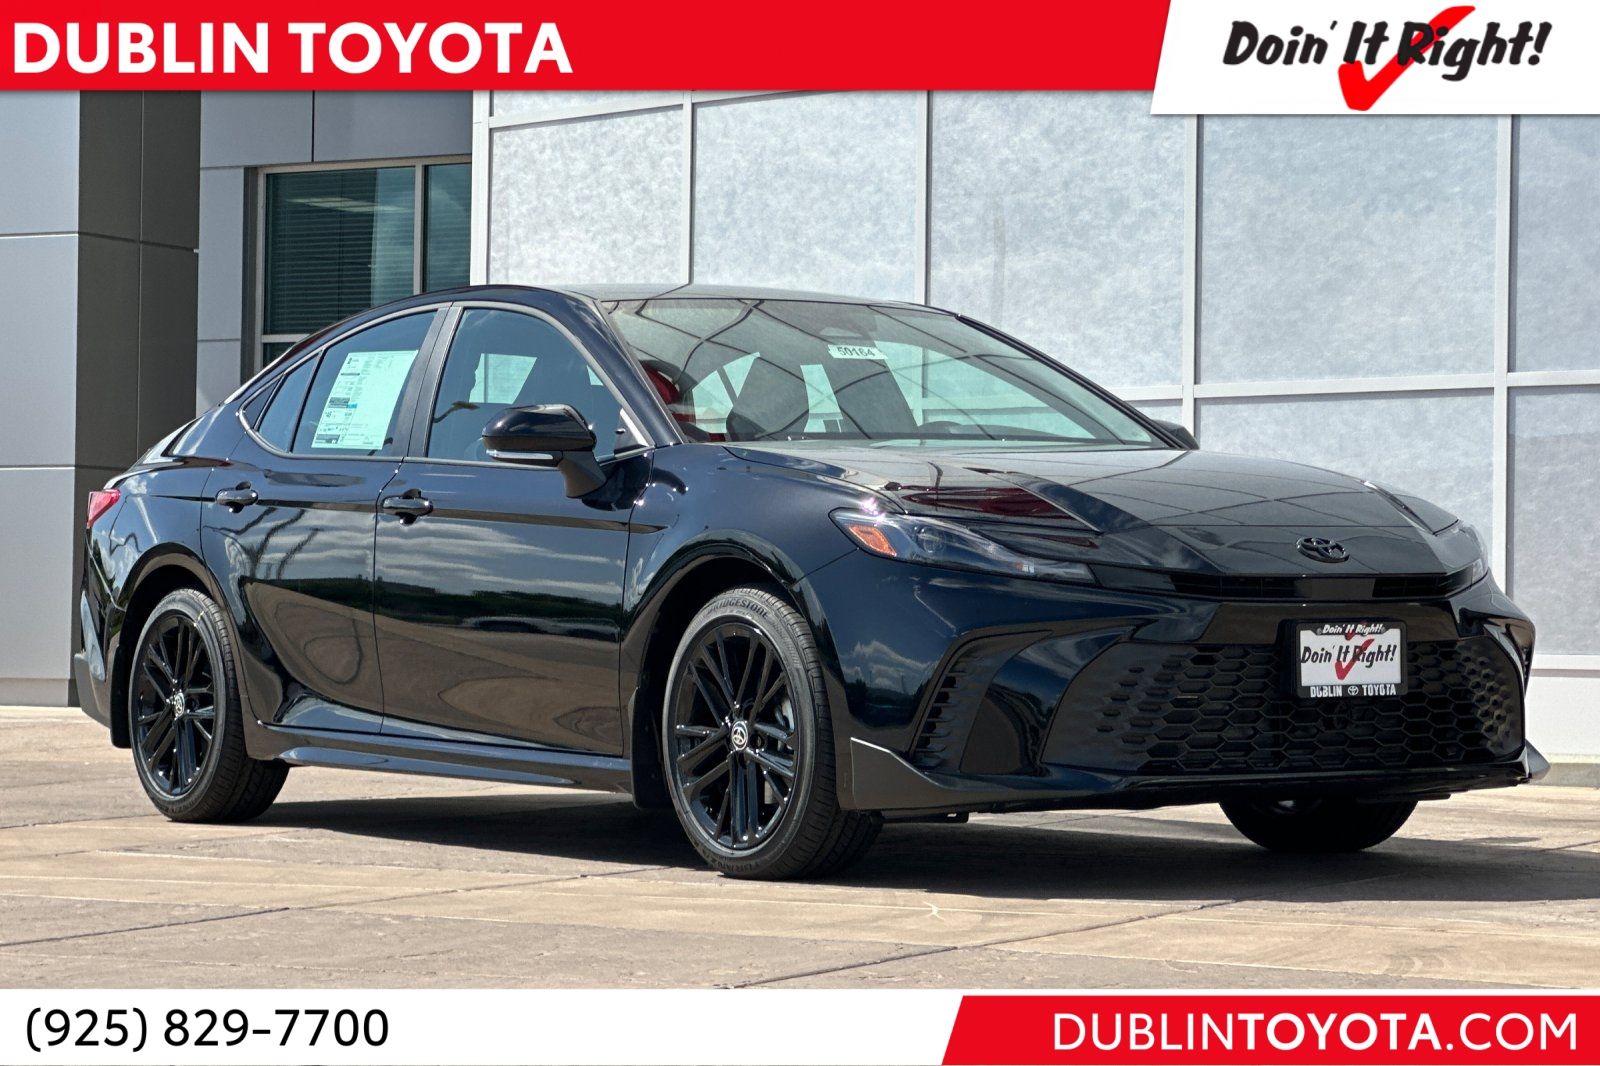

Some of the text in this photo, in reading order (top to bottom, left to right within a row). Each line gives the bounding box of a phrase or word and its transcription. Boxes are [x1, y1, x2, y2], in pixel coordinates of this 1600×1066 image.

[836, 346, 876, 357] 50164
[1345, 624, 1355, 633] It
[1356, 623, 1384, 636] Right!
[1301, 644, 1397, 668] Doin' It Right!
[1310, 684, 1396, 698] DUBLIN TOYOTA
